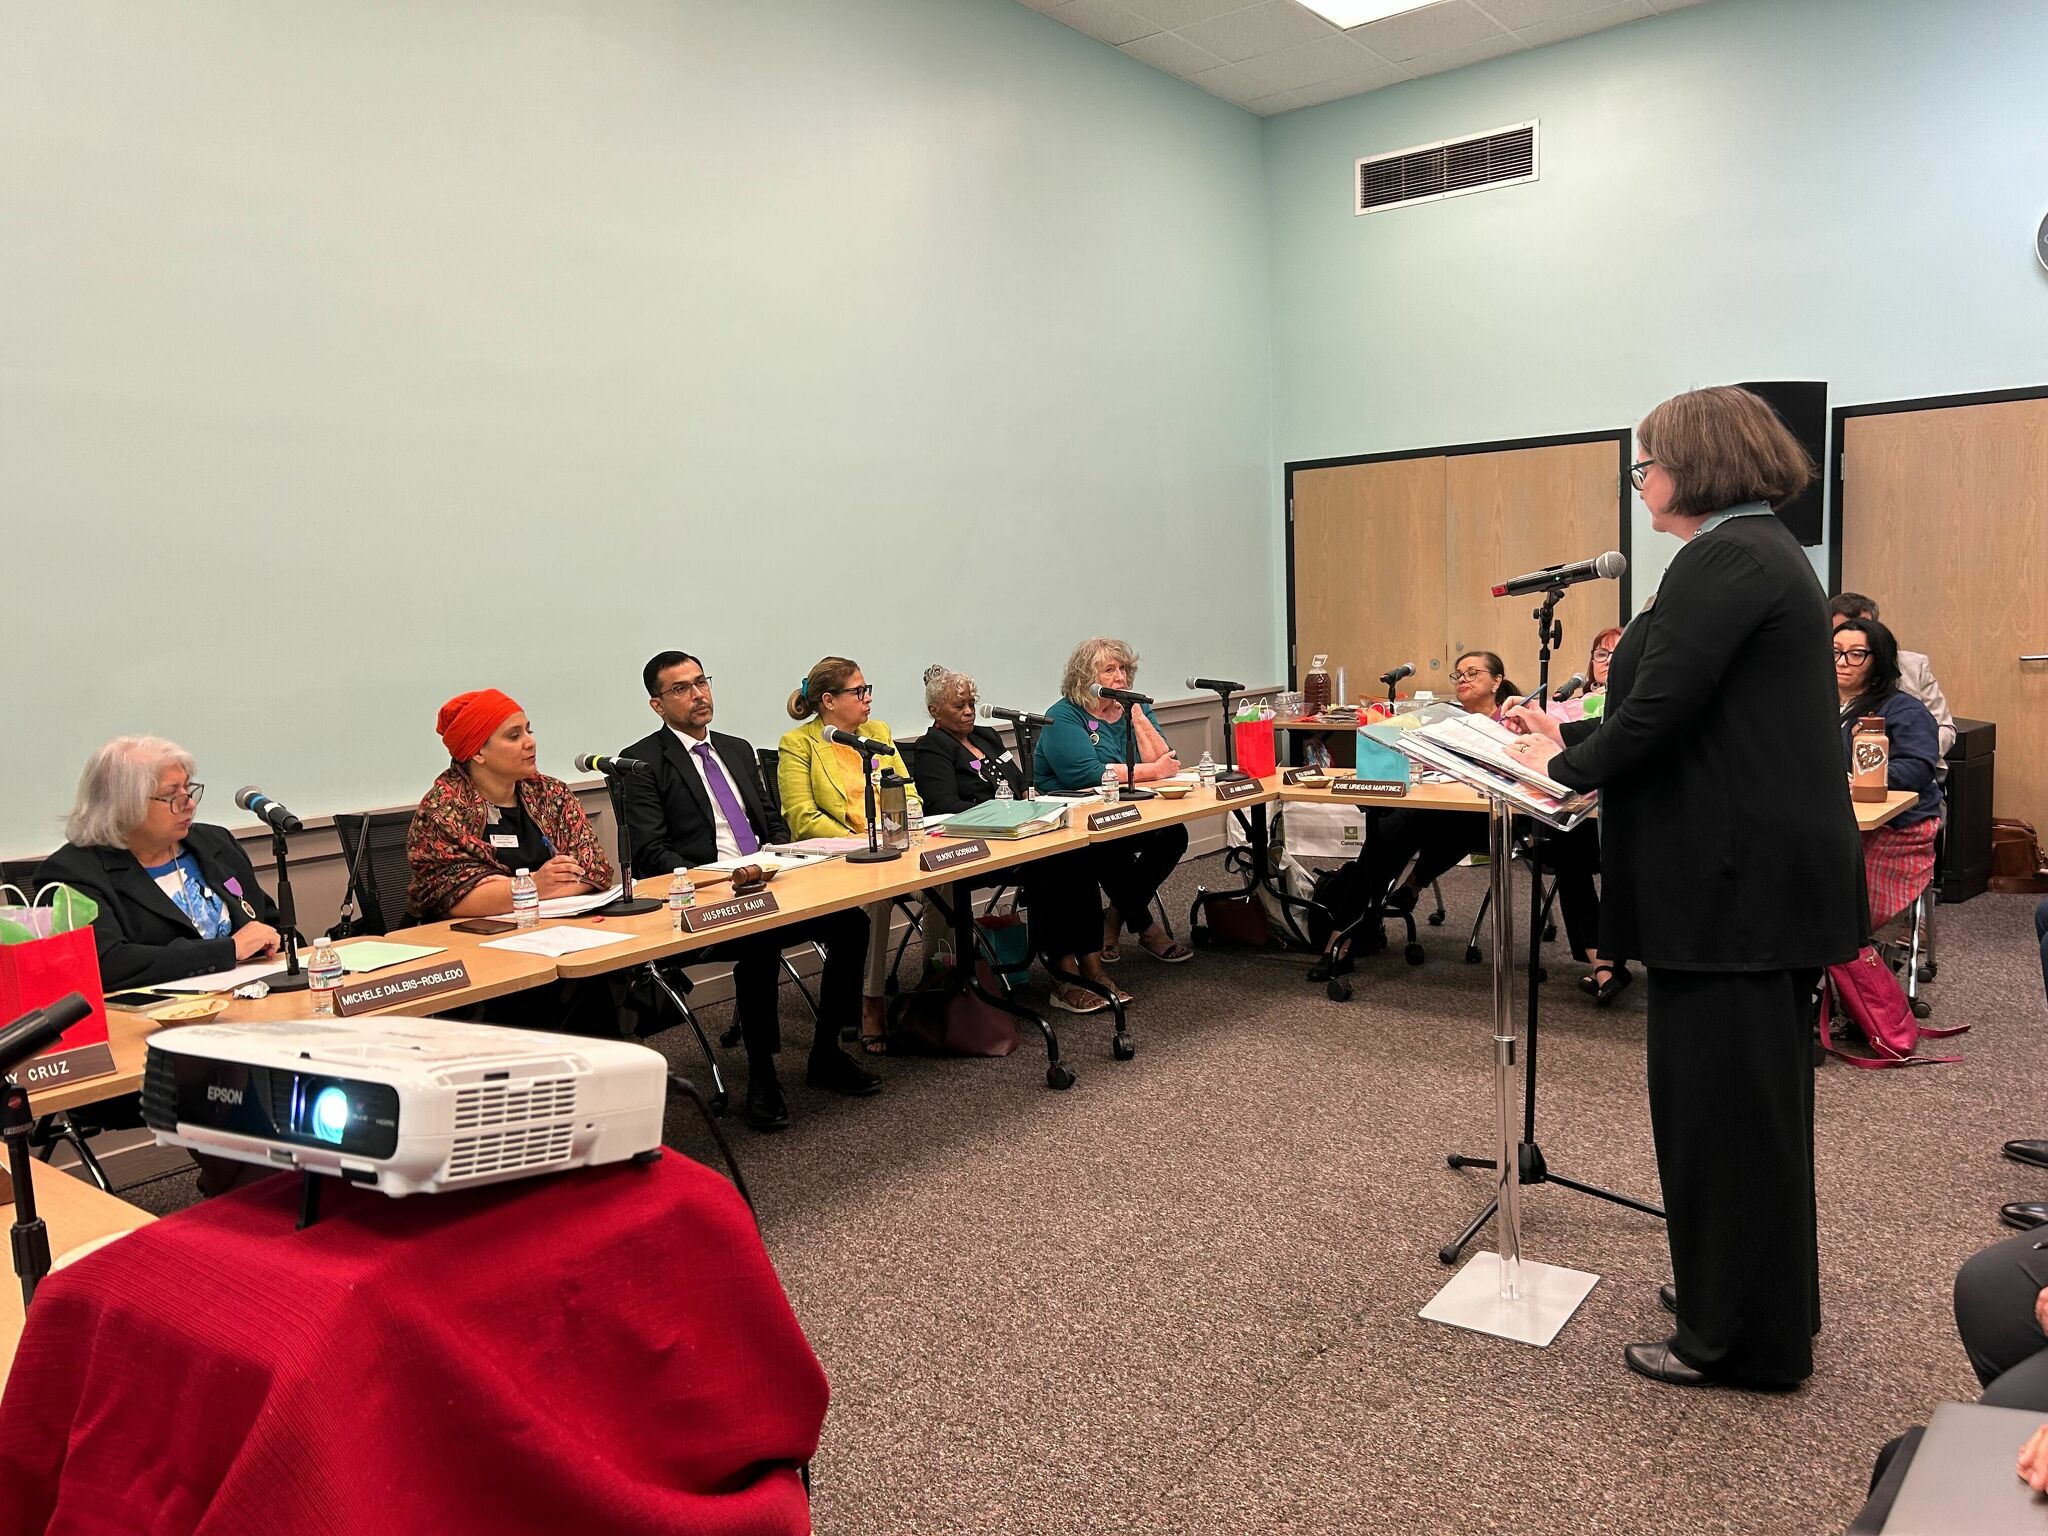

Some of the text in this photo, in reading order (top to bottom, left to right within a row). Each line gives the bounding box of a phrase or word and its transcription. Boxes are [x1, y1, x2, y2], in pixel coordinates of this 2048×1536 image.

[1372, 784, 1402, 792] MARTINEZ
[702, 898, 766, 922] JUSPREET KAUR
[341, 968, 464, 1006] MICHELE DALBIS-ROBLEDO
[27, 1060, 70, 1082] CRUZ
[206, 1085, 243, 1105] EPSON
